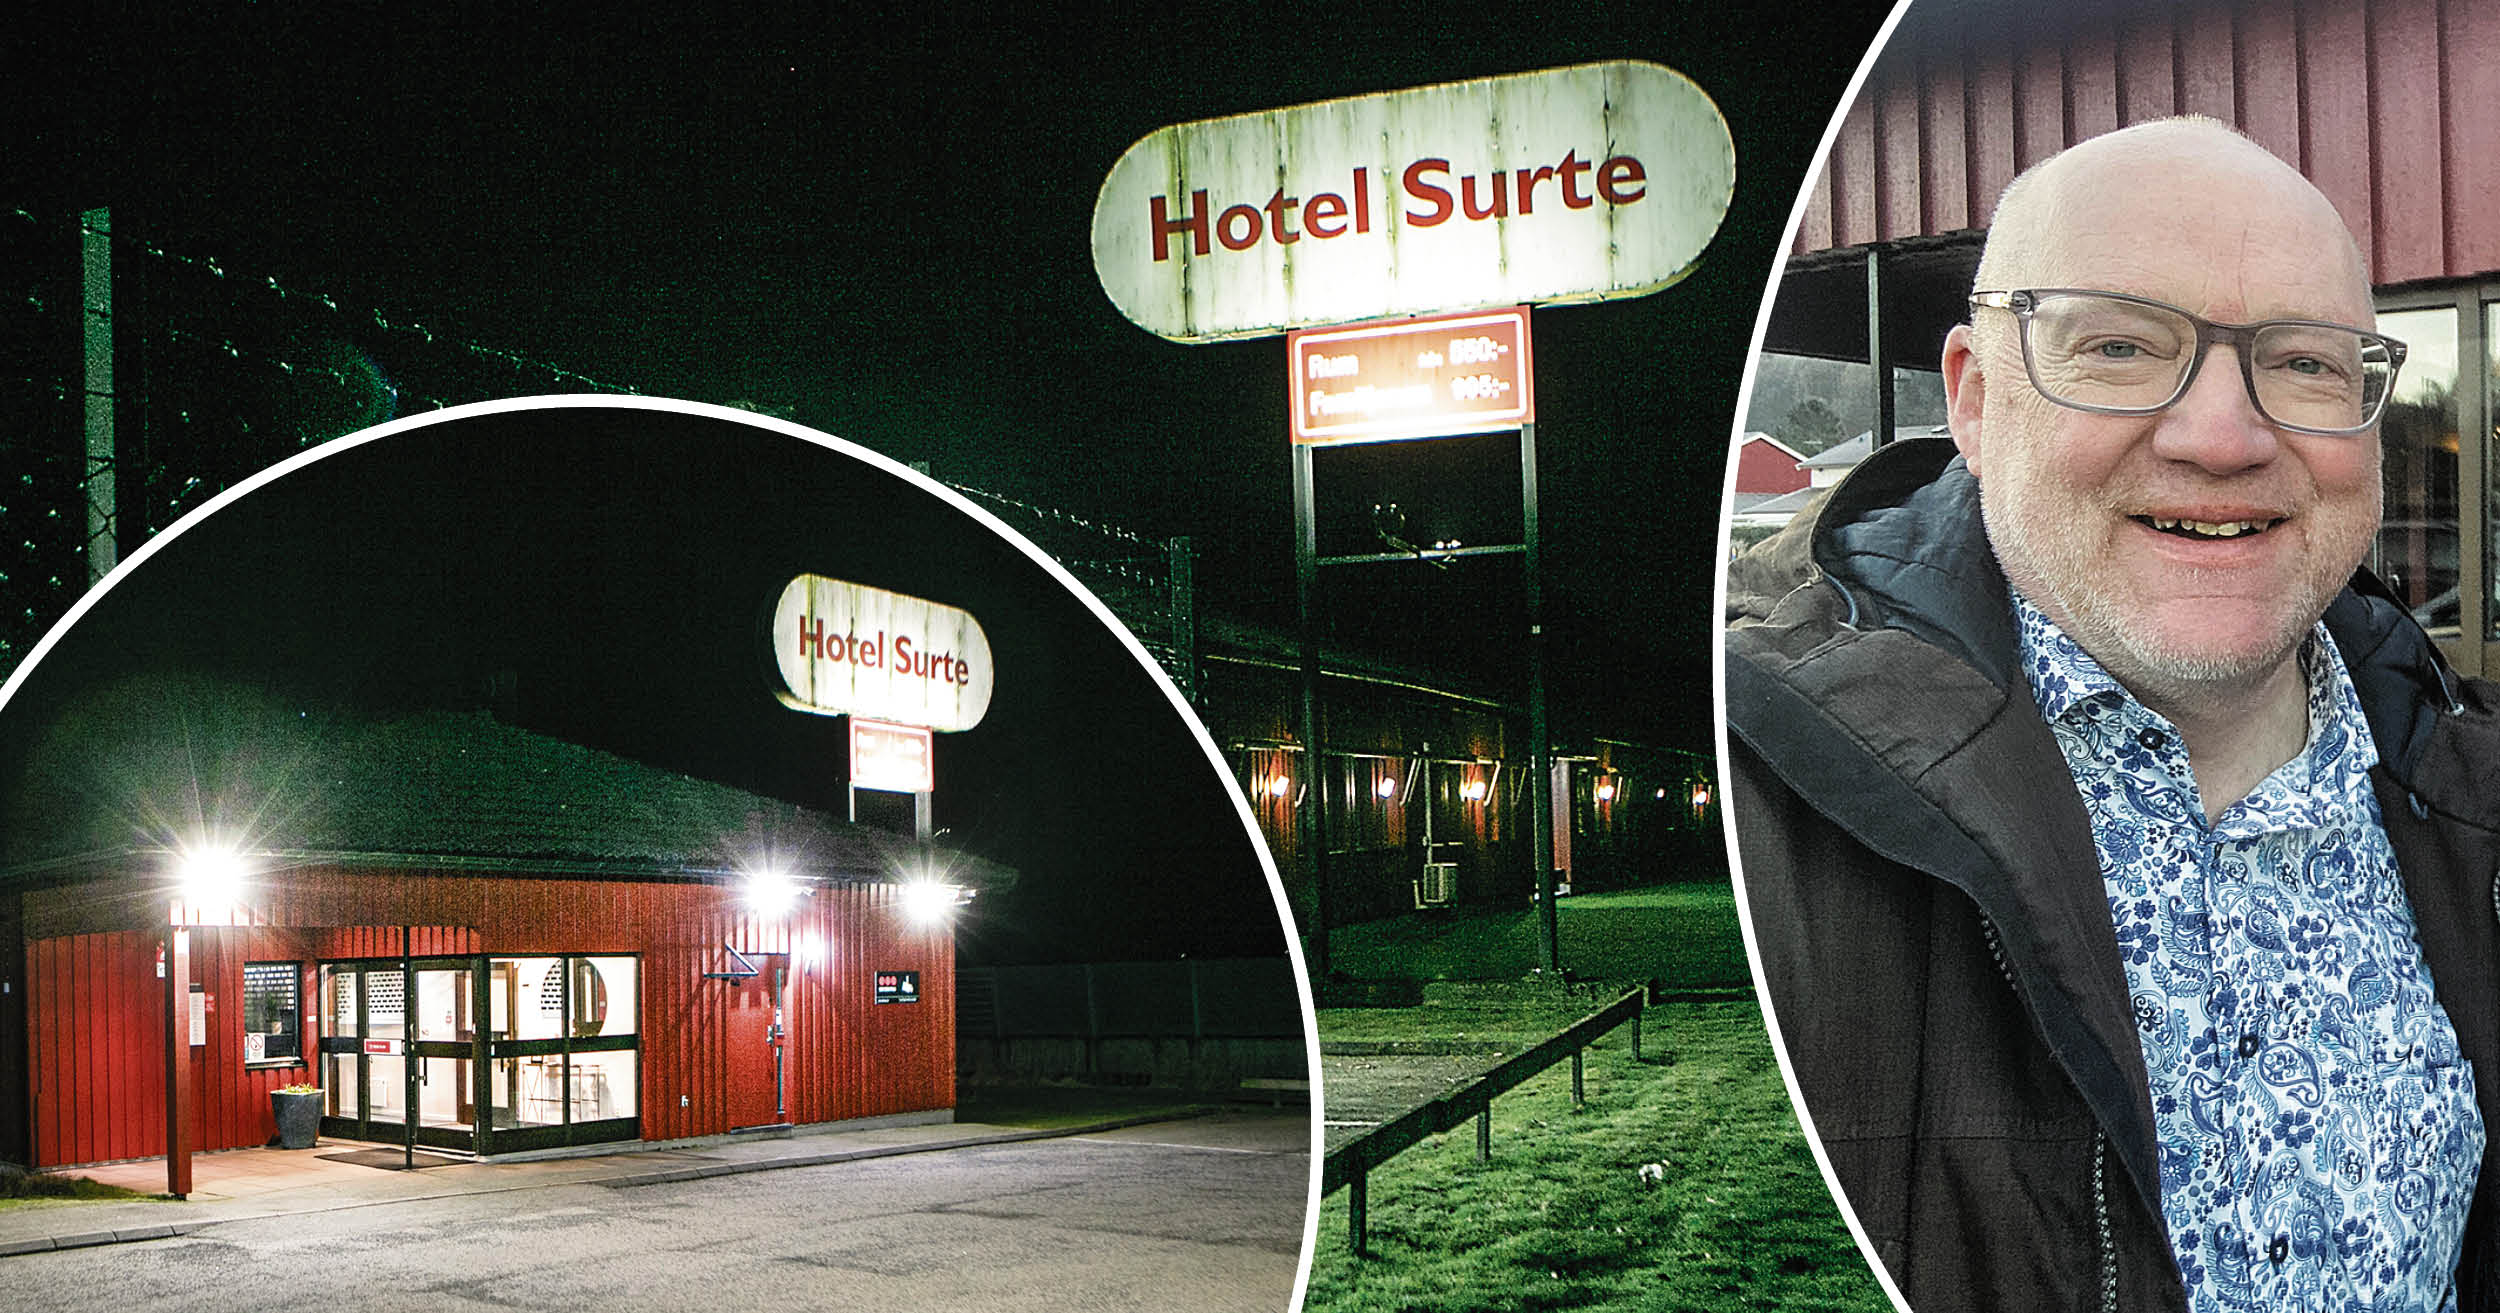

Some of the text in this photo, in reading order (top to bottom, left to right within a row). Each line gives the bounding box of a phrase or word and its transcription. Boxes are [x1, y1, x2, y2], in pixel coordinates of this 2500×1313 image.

[1150, 148, 1646, 262] Hotel Surte
[800, 615, 969, 686] Hotel Surte
